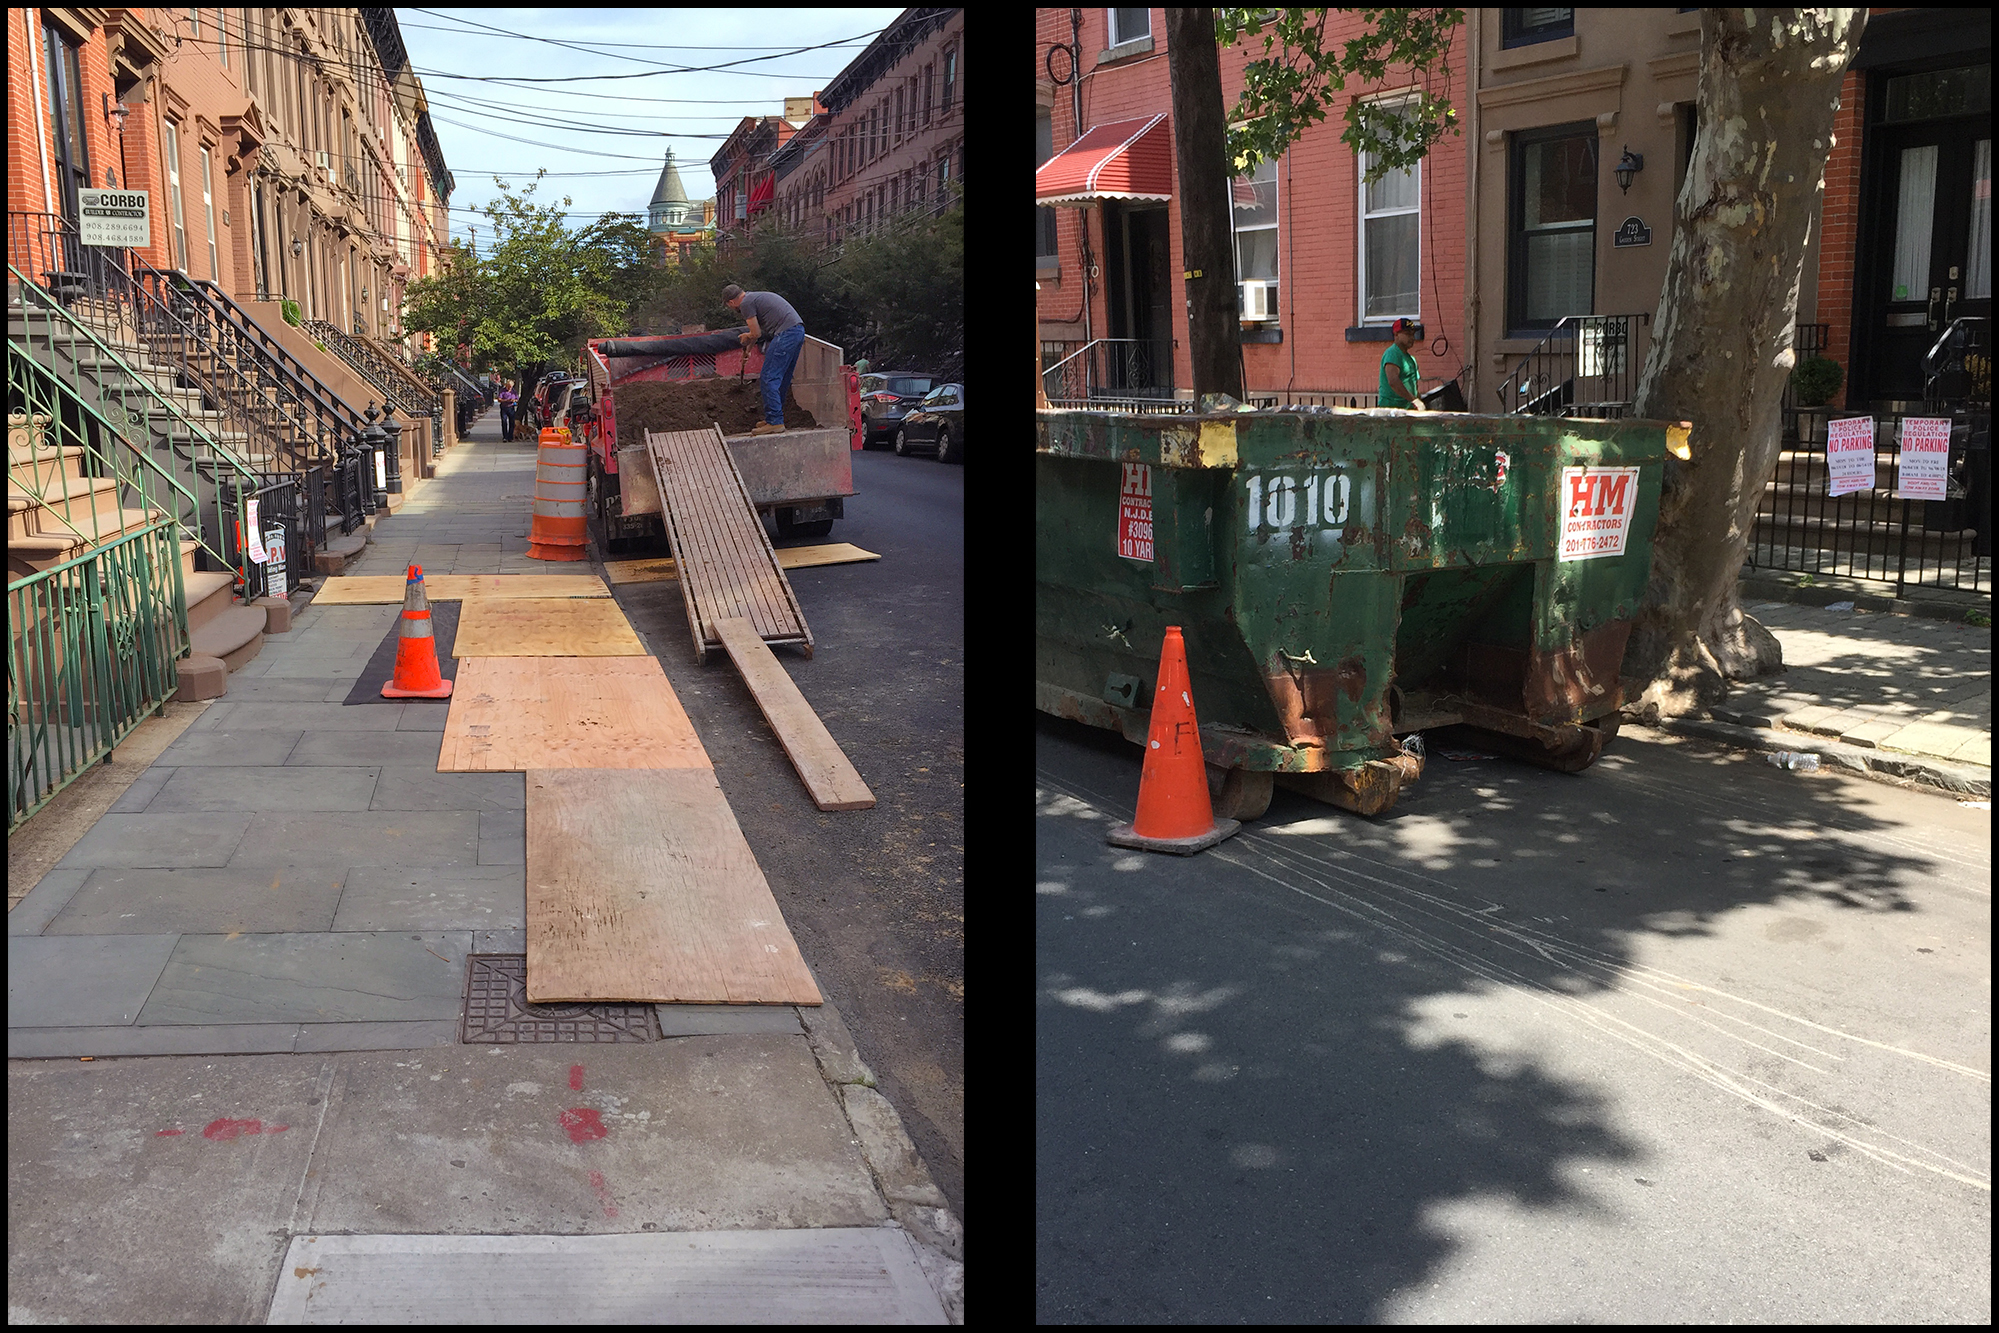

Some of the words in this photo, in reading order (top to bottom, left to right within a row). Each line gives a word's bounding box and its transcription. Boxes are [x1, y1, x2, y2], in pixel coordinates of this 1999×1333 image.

[101, 194, 145, 208] CORBO
[86, 222, 143, 232] 908.289.6694
[1627, 223, 1639, 234] 723
[87, 233, 144, 243] 908.468.4589
[1830, 417, 1870, 428] TEMPORARY
[1830, 430, 1871, 438] REGULATION
[1829, 439, 1839, 453] NO
[1841, 435, 1872, 452] PARKING
[1902, 437, 1912, 452] NO
[1915, 437, 1948, 453] PARKING
[1246, 475, 1350, 529] 1010
[1569, 475, 1629, 518] HM
[1128, 520, 1153, 540] #3096
[1567, 519, 1622, 532] CONTRACTORS
[1122, 538, 1133, 556] 10
[1565, 535, 1619, 552] 201-776-2472
